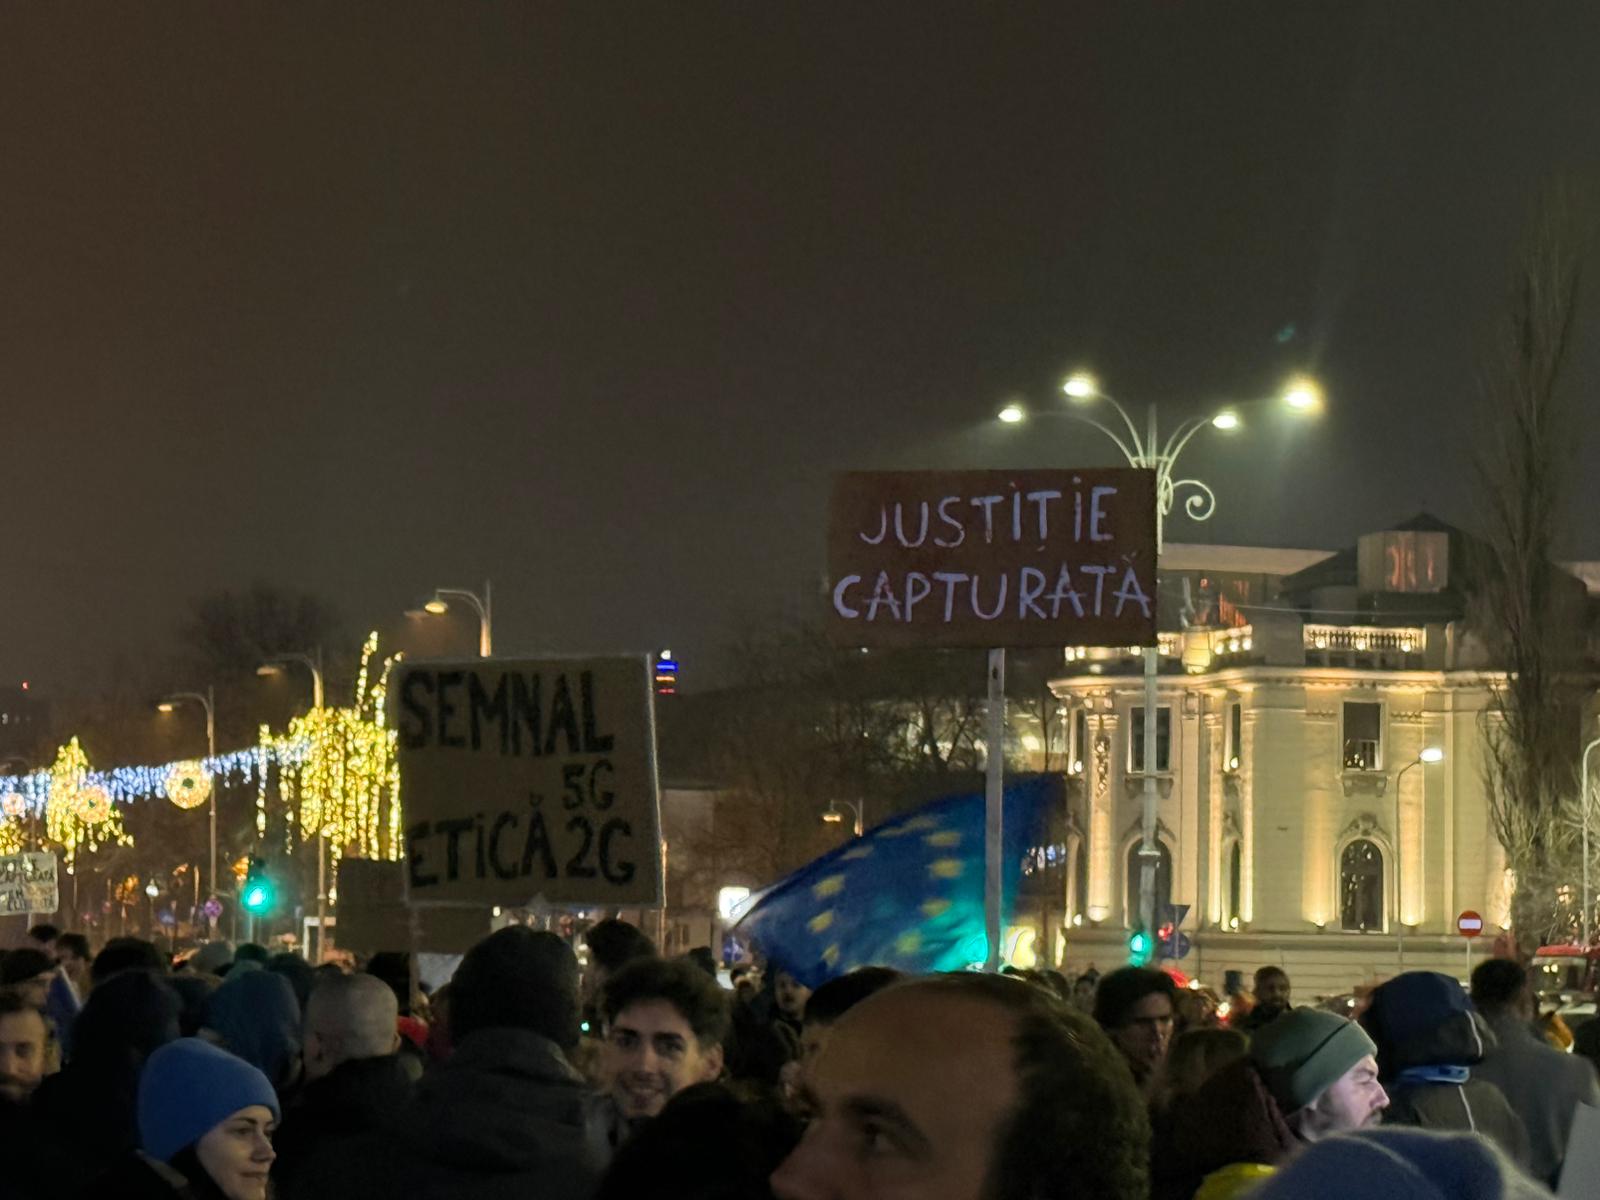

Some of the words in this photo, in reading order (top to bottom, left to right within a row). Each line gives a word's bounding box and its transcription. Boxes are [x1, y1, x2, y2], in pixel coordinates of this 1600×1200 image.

[833, 552, 1151, 622] CAPTURATĂ
[402, 670, 614, 756] SEMNAL
[561, 759, 614, 811] 5G
[565, 816, 635, 886] 2G
